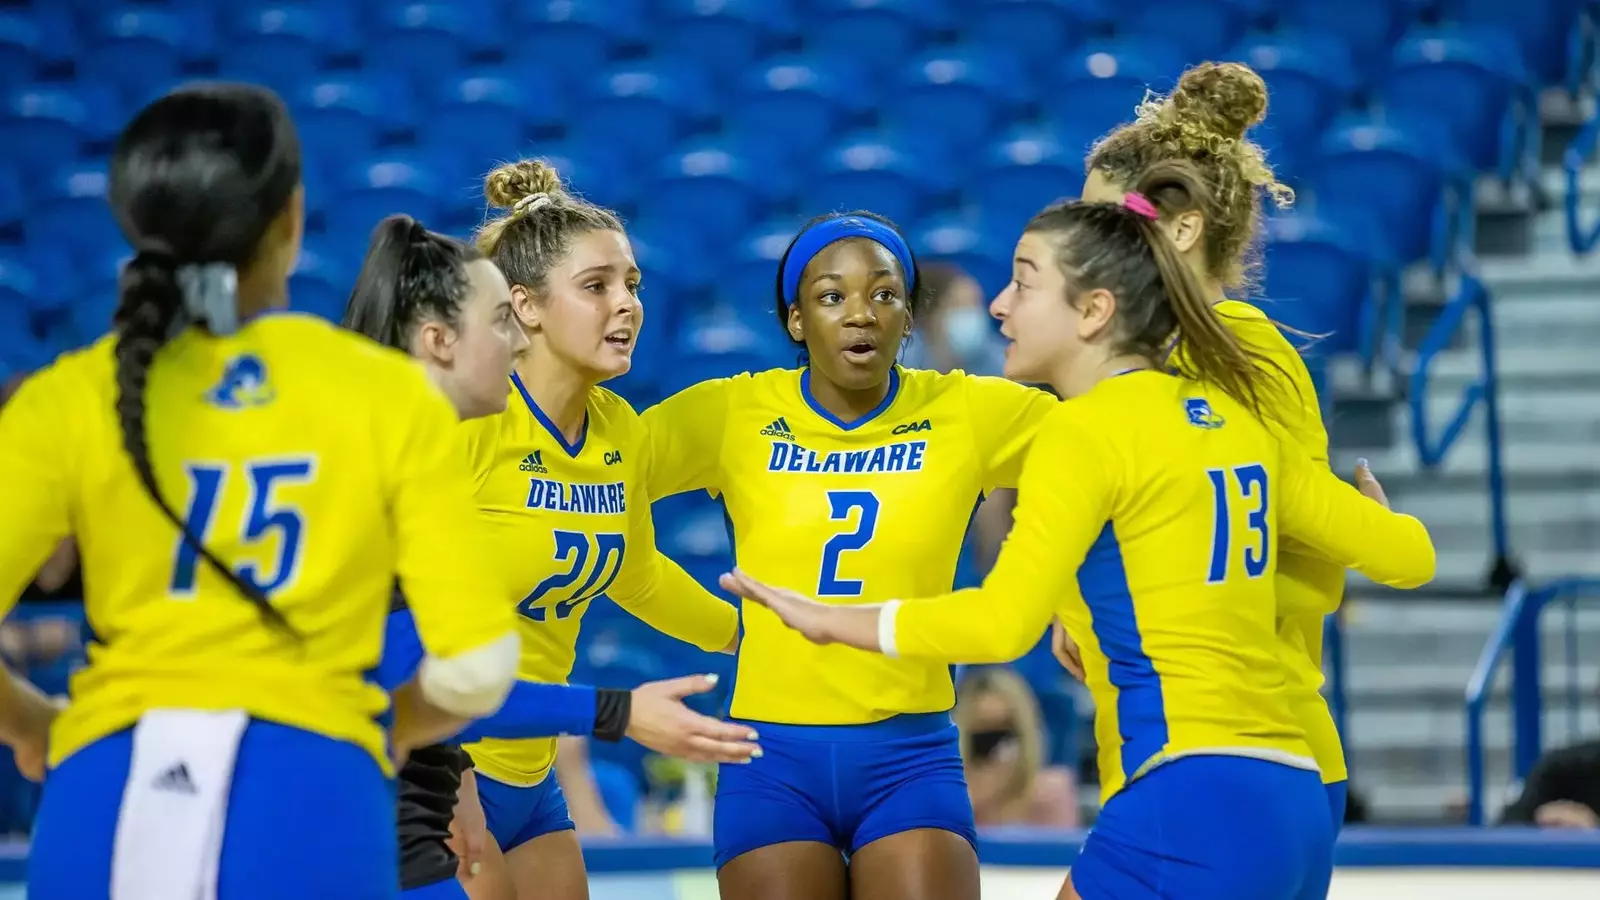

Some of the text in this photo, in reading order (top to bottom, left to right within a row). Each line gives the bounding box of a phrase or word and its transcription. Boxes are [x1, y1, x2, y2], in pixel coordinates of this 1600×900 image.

[760, 428, 796, 441] adidas
[892, 419, 932, 435] CAA
[518, 463, 548, 474] adidas
[768, 440, 928, 473] DELAWARE
[526, 477, 626, 515] DELAWARE
[168, 454, 318, 601] 15
[1206, 462, 1270, 585] 13
[817, 490, 881, 596] 2
[515, 529, 626, 622] 20
